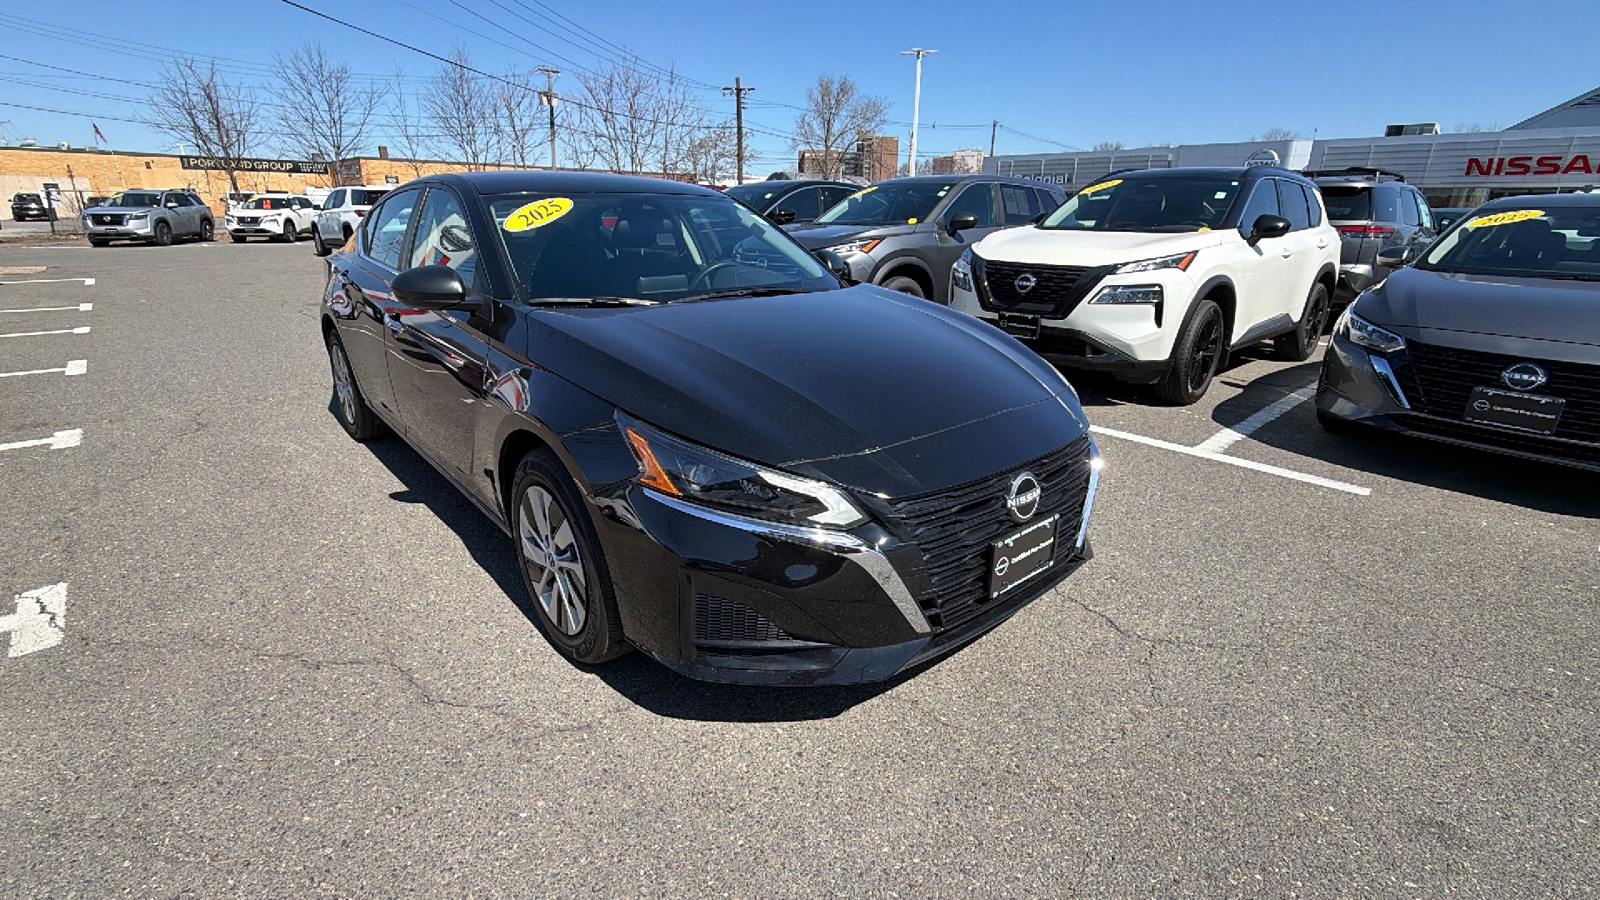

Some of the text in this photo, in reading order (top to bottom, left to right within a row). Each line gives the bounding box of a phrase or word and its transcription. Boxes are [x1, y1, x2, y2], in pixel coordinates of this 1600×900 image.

[190, 157, 252, 169] PORLAND
[253, 161, 294, 171] GROUP
[1464, 155, 1600, 176] NISSA
[517, 200, 562, 227] 2025
[1502, 371, 1547, 382] NISSAN
[1493, 405, 1556, 419] Certified Pre-Owned
[1007, 487, 1041, 508] NISSAN
